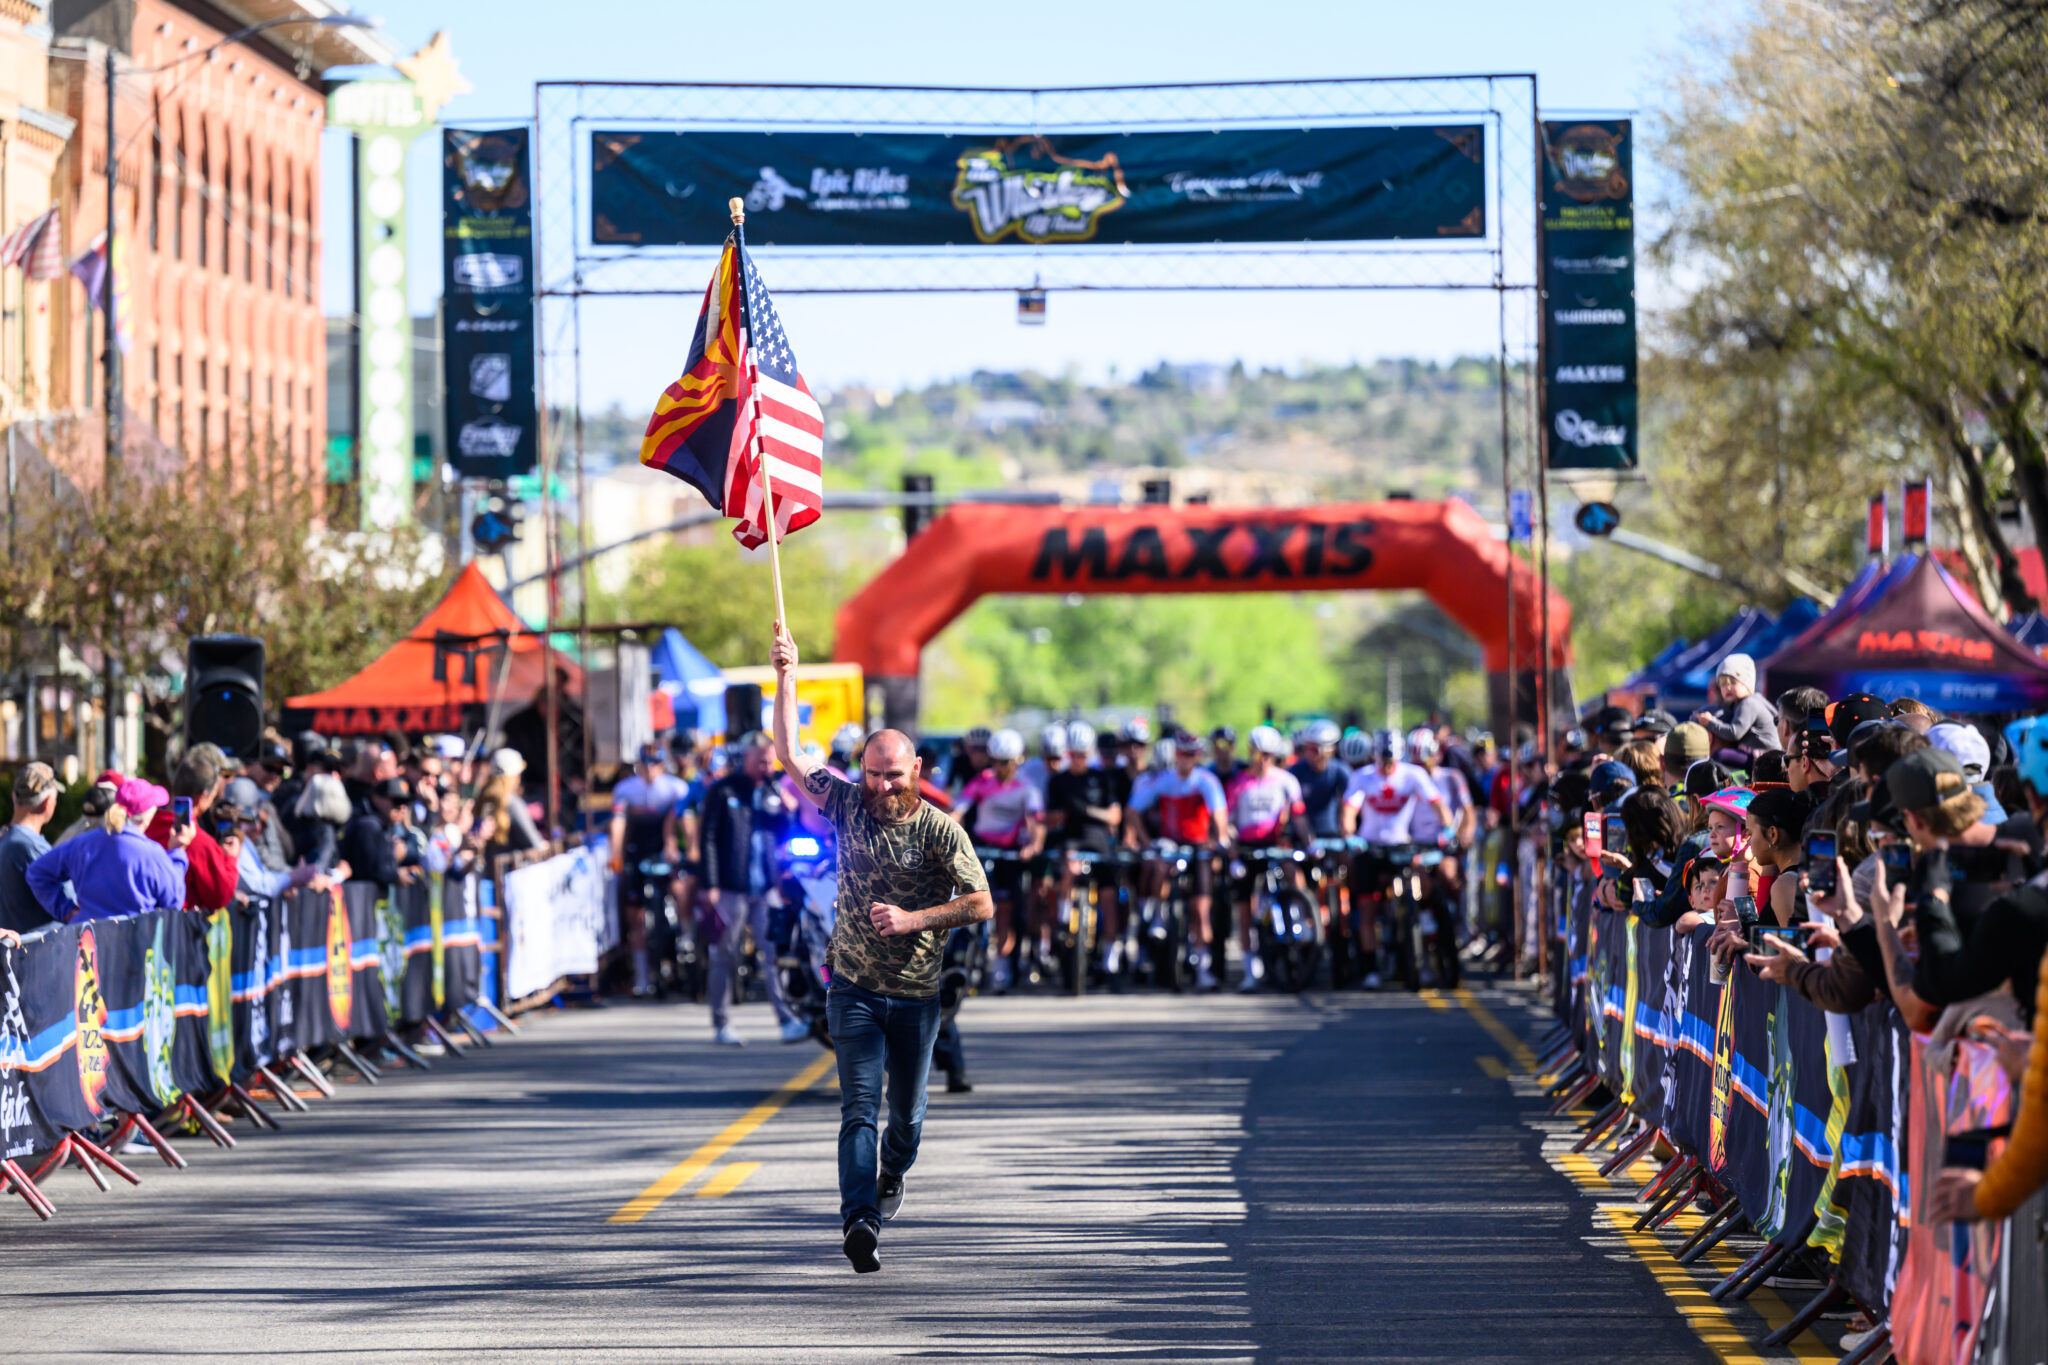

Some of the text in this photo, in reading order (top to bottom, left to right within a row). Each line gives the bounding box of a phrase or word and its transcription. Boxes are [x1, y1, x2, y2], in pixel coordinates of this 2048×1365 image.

[1555, 365, 1625, 383] MAXXIS
[1030, 522, 1376, 581] MAXXIS
[312, 706, 463, 735] MAXXIS
[809, 769, 830, 788] 24
